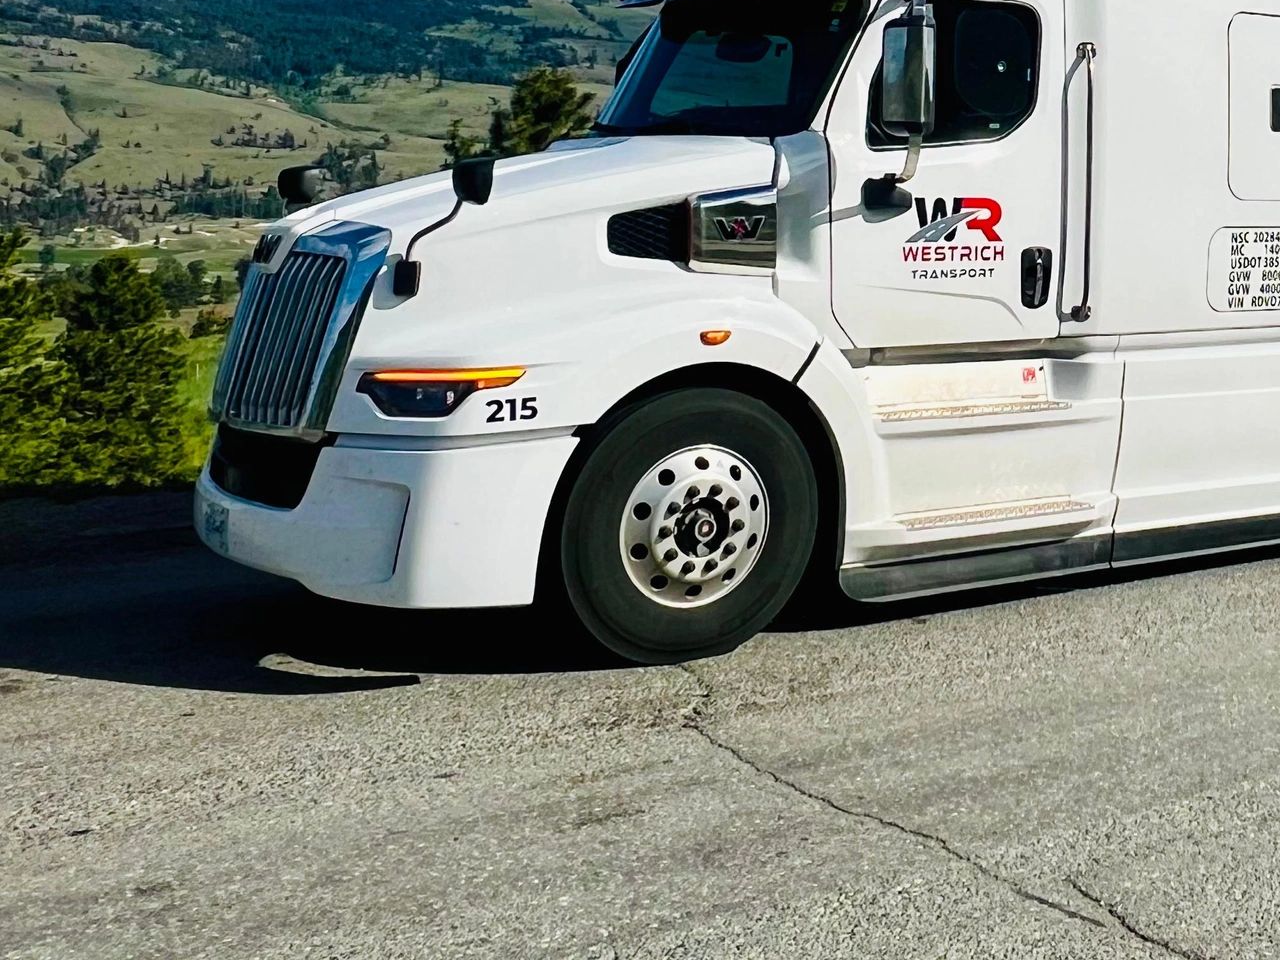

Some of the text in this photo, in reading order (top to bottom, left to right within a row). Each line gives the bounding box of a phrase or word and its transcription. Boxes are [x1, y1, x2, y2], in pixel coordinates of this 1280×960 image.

[904, 197, 1003, 243] WR
[1231, 232, 1249, 243] NSC
[903, 246, 1004, 262] WESTRICH
[1231, 244, 1245, 256] MC
[1231, 257, 1261, 269] USDOT
[912, 268, 995, 279] TRANSPORT
[1229, 271, 1251, 282] GVW
[1228, 283, 1250, 295] GVW
[1228, 296, 1244, 308] VIN
[485, 397, 538, 423] 215
